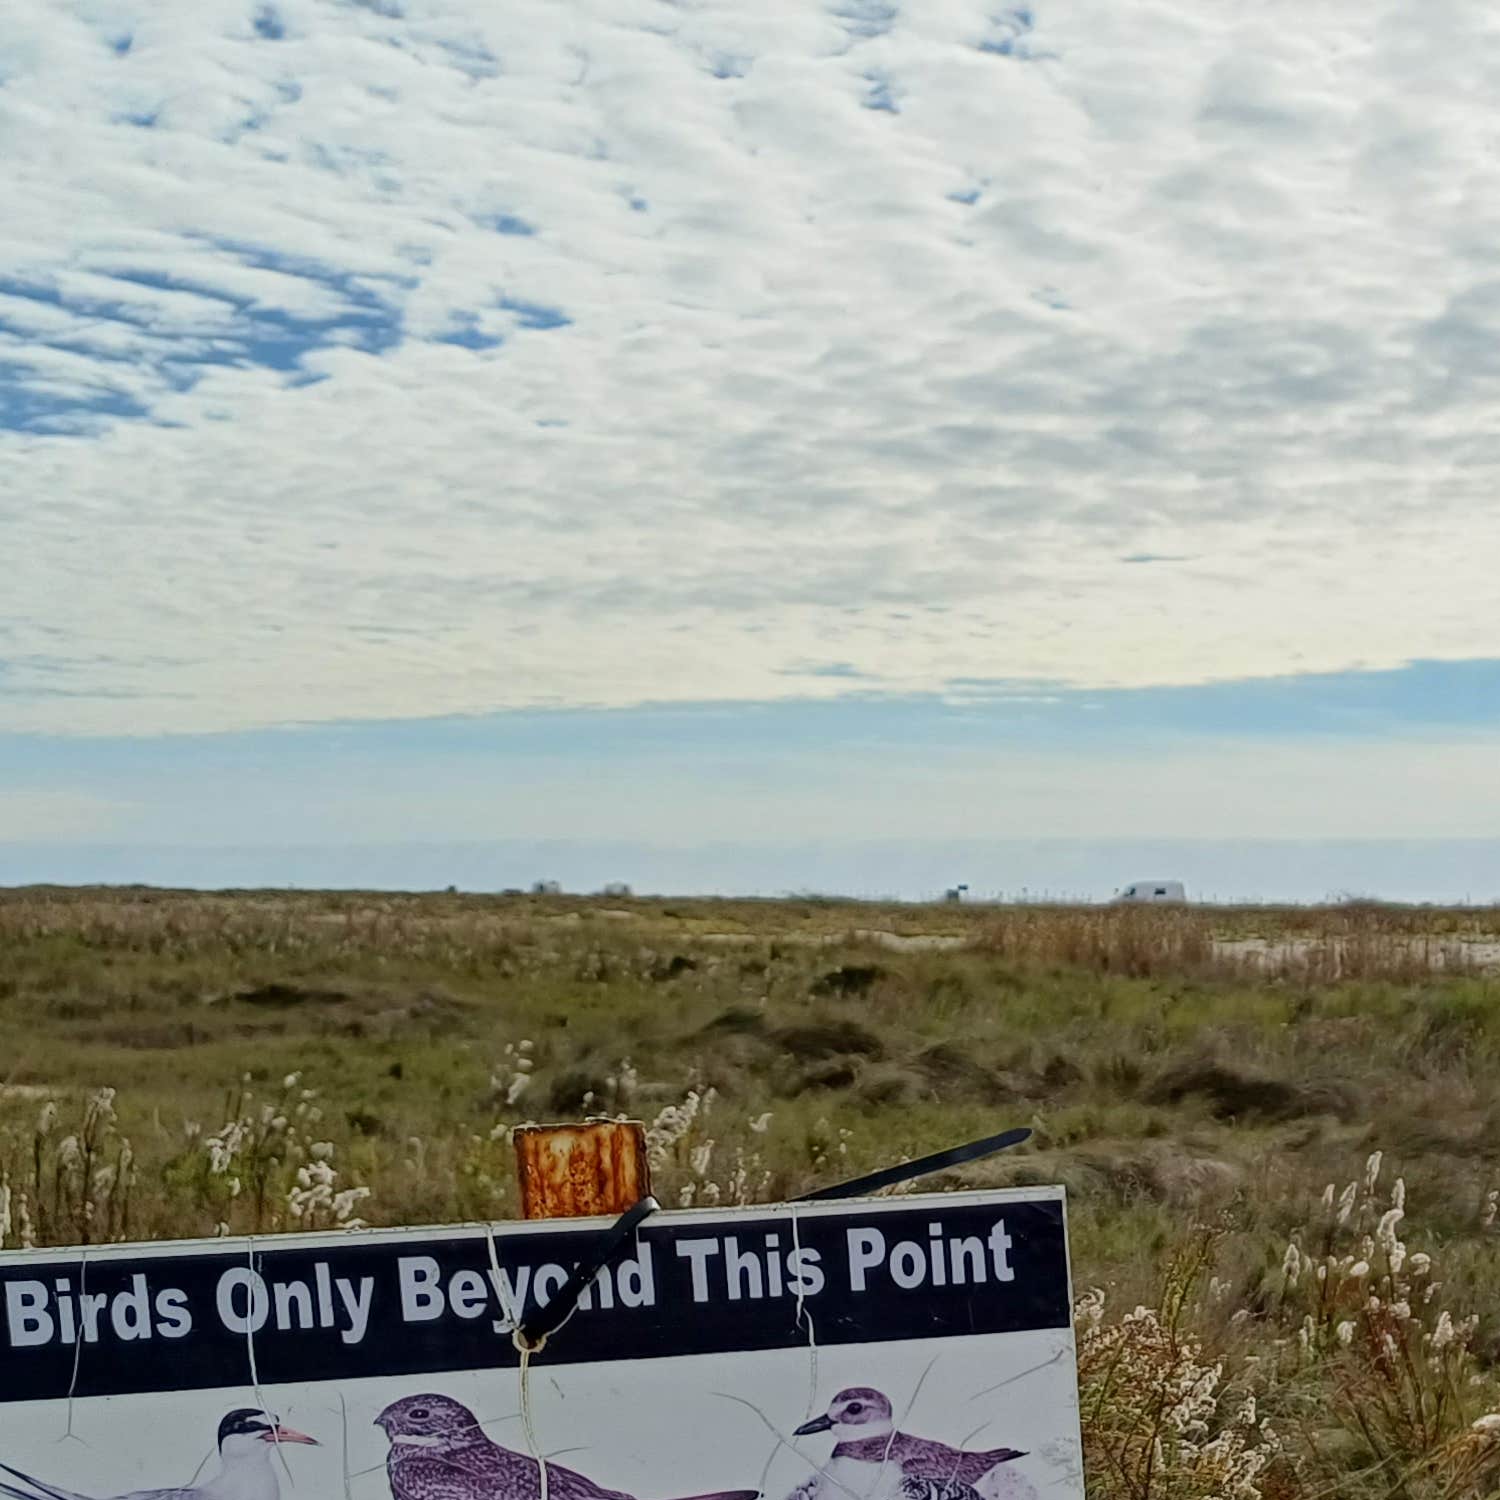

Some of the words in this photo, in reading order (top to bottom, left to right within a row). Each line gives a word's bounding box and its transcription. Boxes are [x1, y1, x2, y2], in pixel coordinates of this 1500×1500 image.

[5, 1273, 193, 1347] Birds
[216, 1267, 375, 1344] Only
[676, 1232, 824, 1303] This
[848, 1220, 1015, 1293] Point
